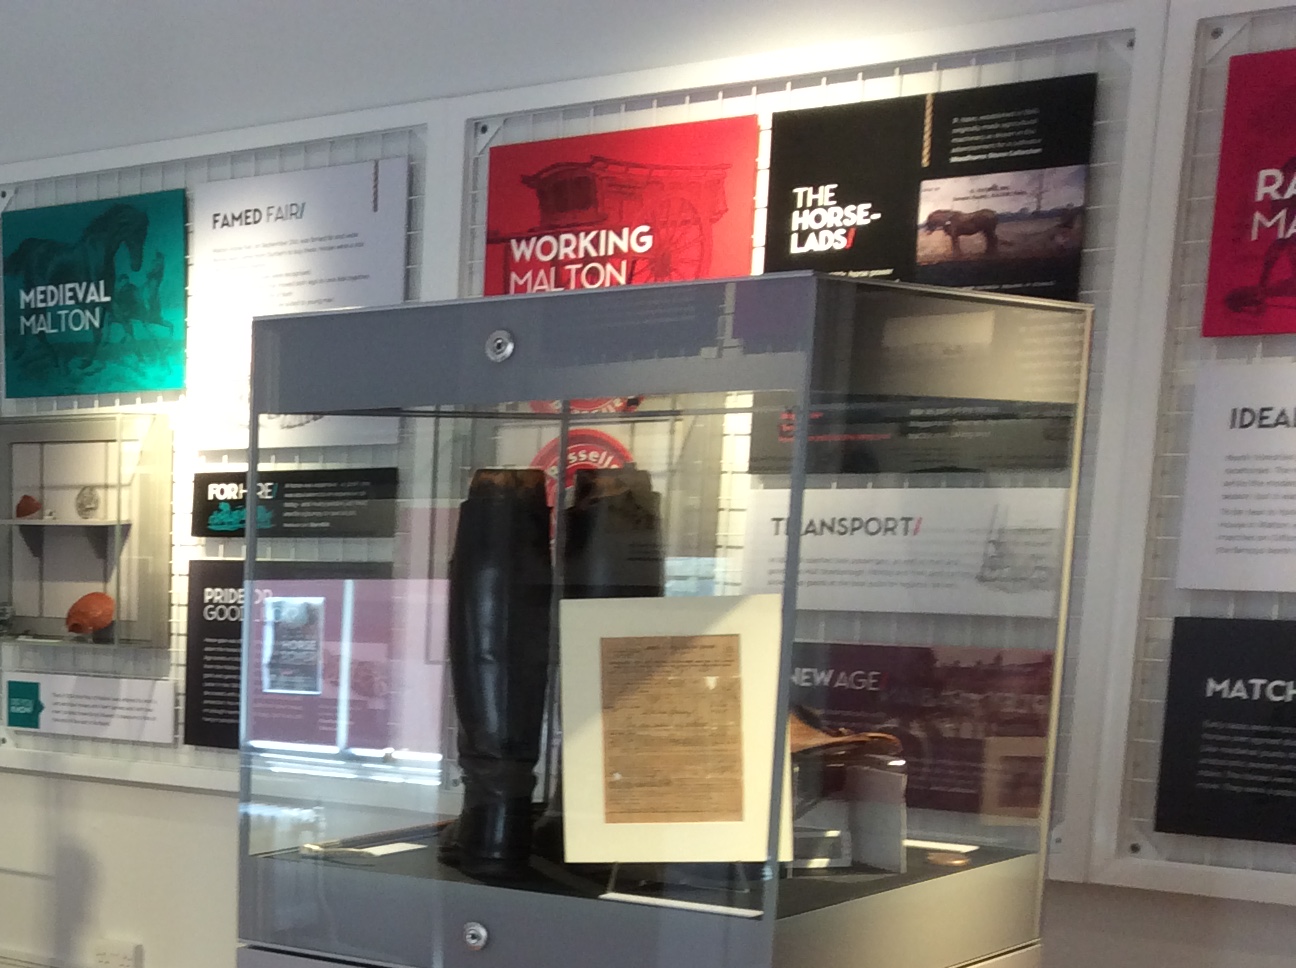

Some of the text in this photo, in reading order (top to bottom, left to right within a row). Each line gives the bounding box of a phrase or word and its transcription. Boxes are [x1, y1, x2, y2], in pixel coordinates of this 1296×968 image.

[792, 183, 839, 209] THE
[212, 208, 263, 229] FAMED
[791, 203, 882, 232] HORSE-
[510, 225, 653, 263] WORKING
[509, 260, 628, 295] MALTON
[19, 279, 111, 309] MEDIEVAL
[19, 308, 101, 335] MALTON
[1228, 406, 1296, 430] IDEA
[207, 483, 238, 500] FOR
[203, 587, 245, 604] PRIDE
